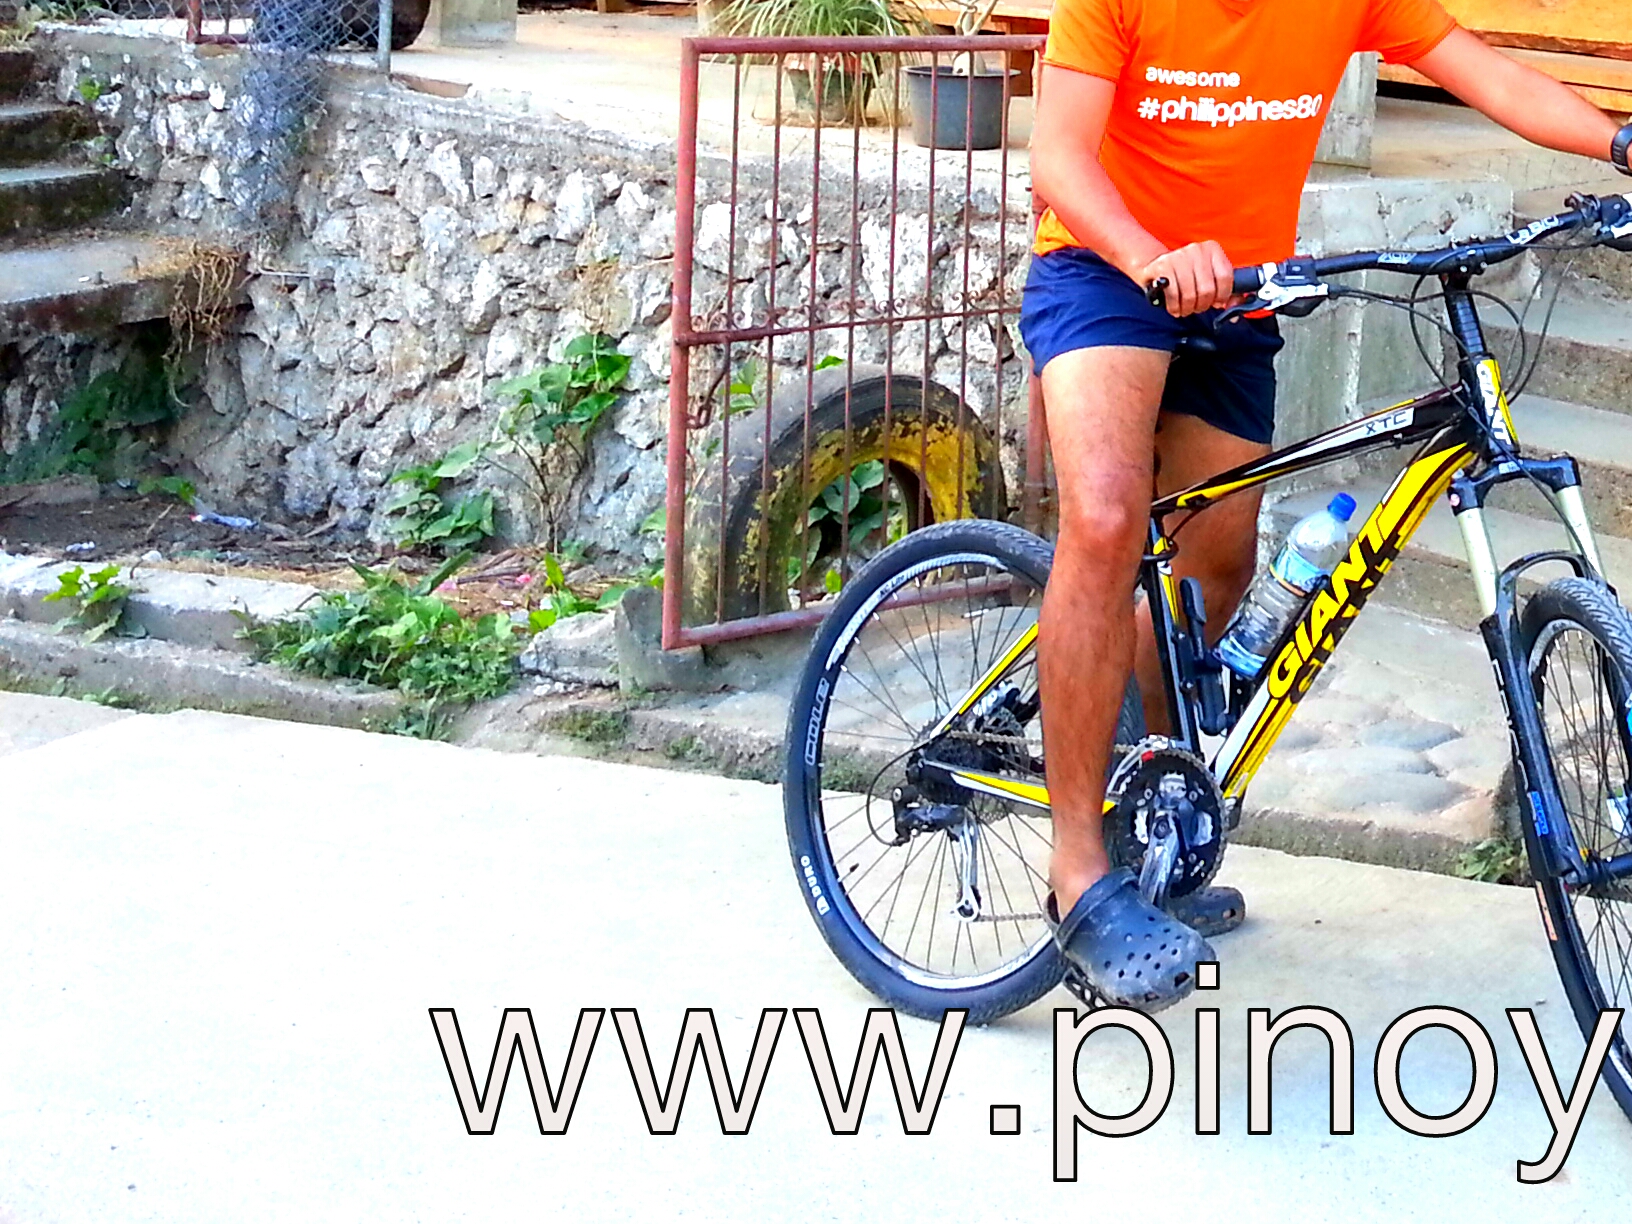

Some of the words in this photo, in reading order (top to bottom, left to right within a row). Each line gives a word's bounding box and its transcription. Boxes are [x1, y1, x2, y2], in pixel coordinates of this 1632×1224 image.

[1145, 66, 1241, 88] awesome
[1365, 410, 1407, 435] XTC
[1476, 362, 1513, 446] GIANT
[1267, 502, 1385, 698] GIANT
[801, 856, 822, 898] DURO
